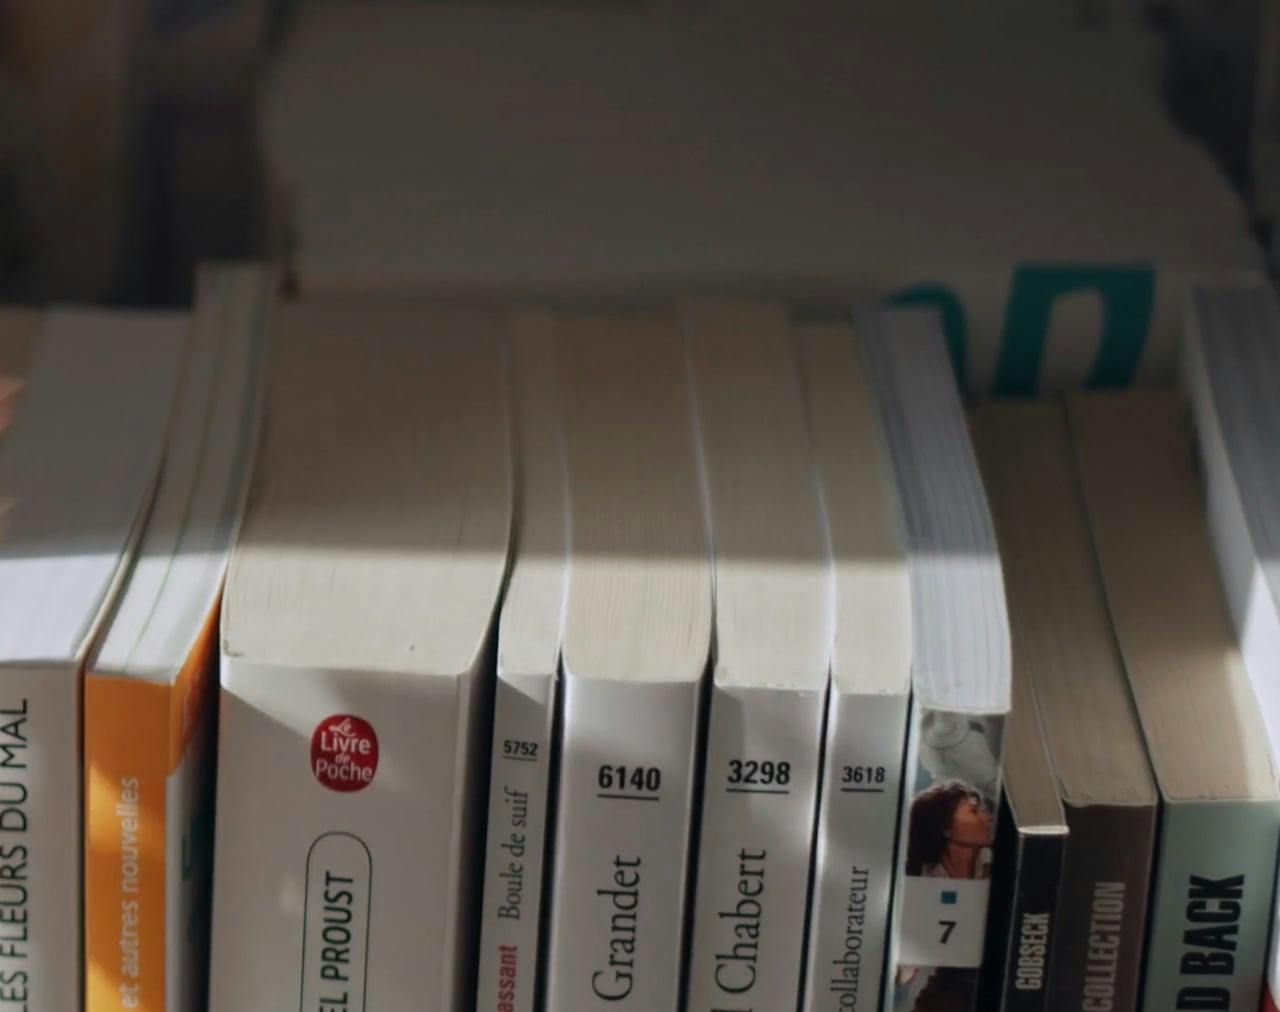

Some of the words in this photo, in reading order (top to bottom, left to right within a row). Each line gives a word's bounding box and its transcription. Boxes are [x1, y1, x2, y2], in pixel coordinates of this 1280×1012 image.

[320, 731, 371, 755] Livre
[503, 739, 539, 757] 5752
[316, 758, 374, 783] Poche
[597, 765, 662, 792] 6140
[726, 759, 792, 787] 3298
[842, 765, 885, 784] 3618
[503, 785, 529, 829] suif
[116, 776, 139, 894] nouvelles
[501, 832, 526, 858] de
[497, 862, 524, 921] Boule
[119, 900, 139, 978] autres
[321, 870, 355, 981] PROUST
[591, 855, 643, 1004] Grandet
[715, 848, 768, 999] Chabert
[938, 920, 957, 945] 7
[1180, 874, 1246, 976] BACK
[1014, 912, 1051, 992] GOBSECK
[1082, 881, 1126, 1012] COLLECTION
[119, 982, 139, 1009] et
